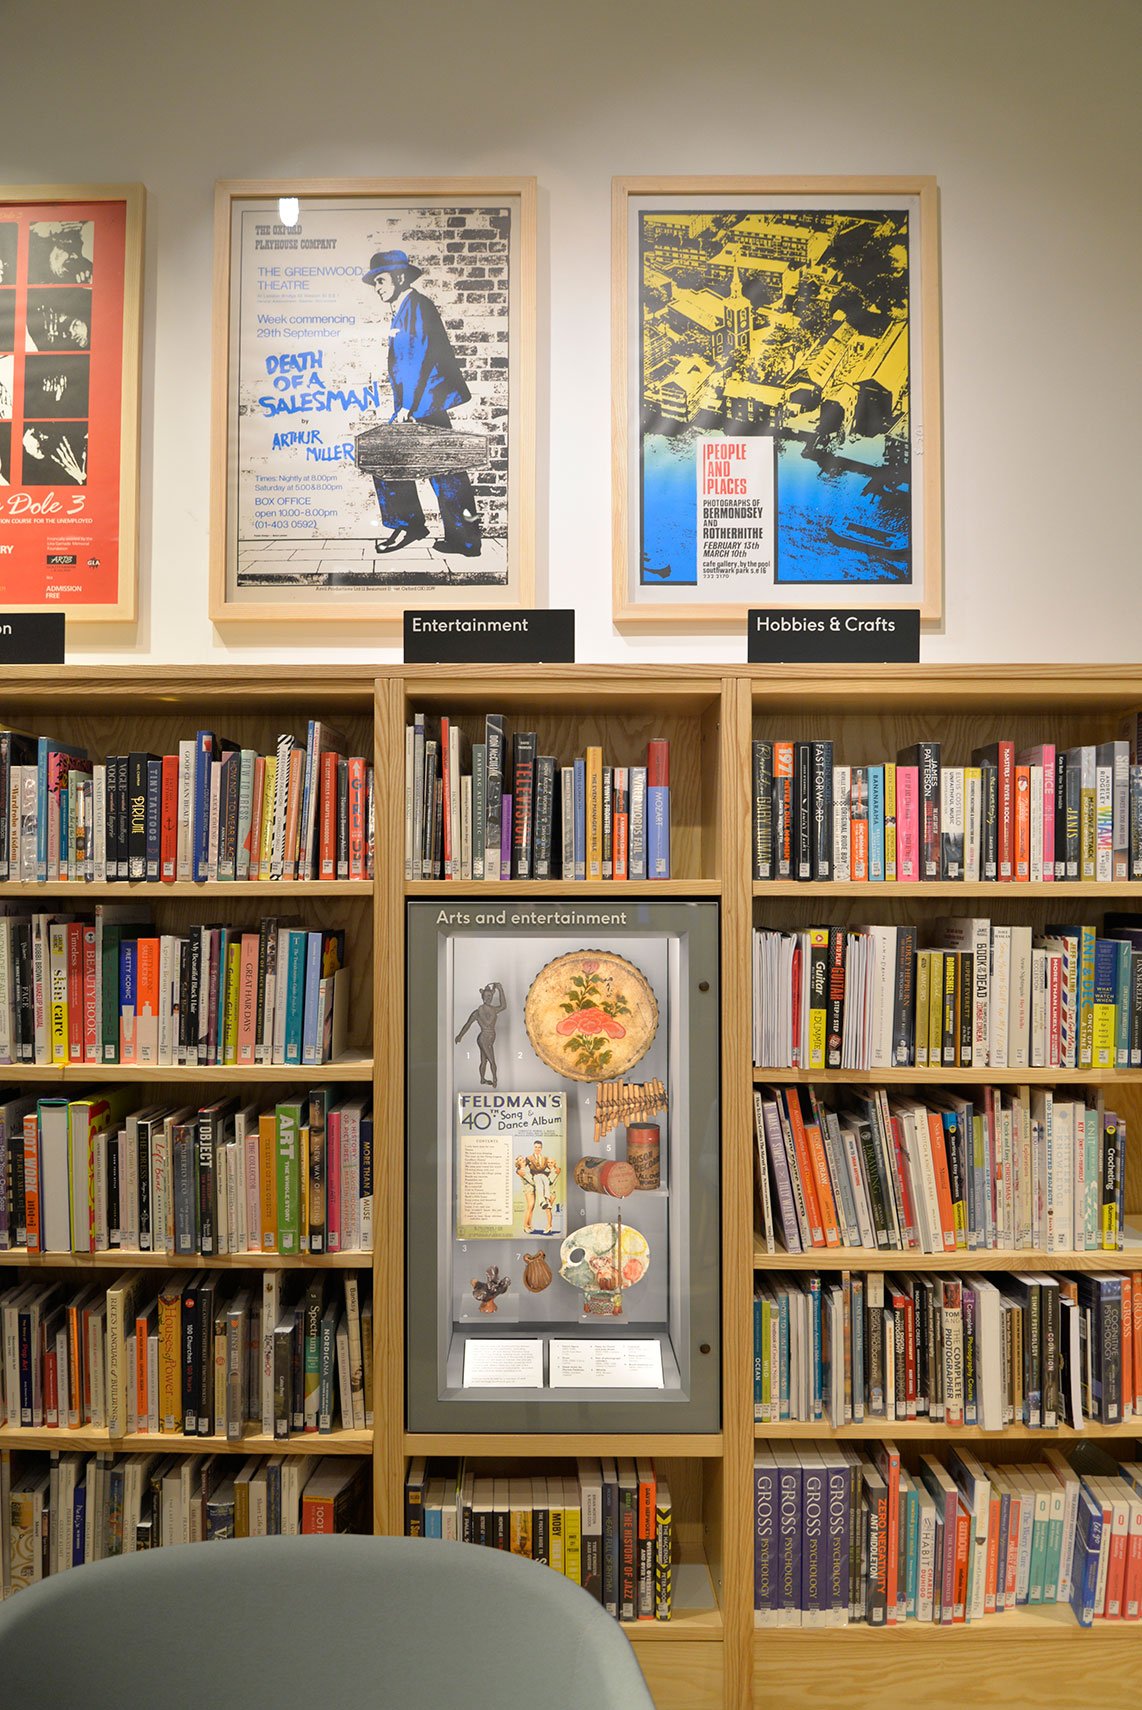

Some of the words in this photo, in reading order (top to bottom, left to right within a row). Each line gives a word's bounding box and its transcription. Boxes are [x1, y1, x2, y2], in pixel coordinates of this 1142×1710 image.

[255, 225, 270, 235] THE
[255, 239, 298, 250] PLAYHOUSE
[300, 239, 337, 250] COMPANY
[258, 267, 280, 276] THE
[258, 281, 310, 290] THEATRE
[257, 314, 288, 324] Week
[289, 314, 356, 326] commencing
[257, 328, 281, 338] 29th
[284, 328, 340, 340] September
[265, 350, 323, 375] DEATH
[274, 375, 303, 391] OF
[307, 372, 326, 389] A
[258, 381, 380, 417] SALESMAN
[272, 430, 323, 450] ARTHUR
[306, 443, 355, 462] MILLER
[707, 444, 746, 460] PEOPLE
[279, 475, 302, 483] Nightly
[311, 475, 337, 483] 8.00pm
[708, 461, 730, 477] AND
[255, 484, 286, 492] Saturday
[708, 479, 747, 494] PLACES
[7, 492, 62, 515] Dole
[67, 495, 86, 515] 3
[277, 497, 311, 505] OFFICE
[255, 510, 276, 518] open
[703, 507, 763, 519] BERMONDSEY
[703, 519, 718, 527] AND
[255, 520, 288, 529] (01-403
[290, 520, 317, 529] 0592)
[703, 528, 763, 539] ROTHERHITHE
[703, 550, 730, 558] MARCH
[731, 550, 747, 558] 10th
[758, 560, 770, 569] pool
[736, 567, 749, 575] park
[413, 617, 528, 632] Entertainment
[757, 617, 825, 632] Hobbies
[830, 617, 840, 632] &
[845, 617, 895, 632] Crafts
[515, 762, 532, 844] TELEVISION
[655, 792, 663, 826] MOZART
[149, 797, 157, 841] TATTOOS
[1066, 807, 1078, 838] JANIS
[437, 911, 470, 924] Arts
[475, 911, 505, 924] and
[511, 911, 627, 925] entertainment
[71, 930, 79, 966] Timeless
[976, 943, 987, 966] BOOK
[35, 962, 43, 982] BROWN
[86, 950, 96, 1000] BEAUTY
[245, 963, 253, 989] GREAT
[814, 961, 826, 995] Guitar
[946, 957, 954, 994] BOMBSHELL
[903, 968, 911, 1006] HEPBURN
[976, 974, 987, 998] DEAD
[244, 990, 252, 1010] HAIR
[87, 1002, 96, 1036] BOOK
[243, 1011, 251, 1032] DAYS
[462, 1094, 561, 1108] FELDMAN'S
[498, 1120, 529, 1131] Dance
[532, 1117, 562, 1126] Album
[500, 1110, 523, 1120] Song
[24, 1122, 36, 1152] FOOT
[200, 1127, 212, 1168] OBJECT
[280, 1114, 294, 1159] ART
[25, 1158, 36, 1194] WORK
[1106, 1148, 1115, 1190] Crocheting
[165, 1308, 176, 1352] Houses
[308, 1305, 319, 1352] Spectrum
[946, 1328, 954, 1399] PHOTOGRAPHER
[954, 1347, 962, 1399] COMPLETE
[165, 1361, 176, 1396] Power
[757, 1476, 772, 1536] GROSS
[781, 1475, 796, 1535] GROSS
[806, 1477, 821, 1536] GROSS
[830, 1475, 845, 1535] GROSS
[878, 1499, 886, 1529] ZERO
[552, 1513, 561, 1536] MOBY
[624, 1512, 633, 1528] THE
[870, 1513, 878, 1530] ANT
[624, 1530, 633, 1564] HISTORY
[870, 1532, 878, 1579] MIDDLETON
[922, 1532, 931, 1566] HABIT
[624, 1568, 633, 1577] OF
[877, 1531, 886, 1594] NEGATIVITY
[624, 1580, 633, 1599] JAZZ
